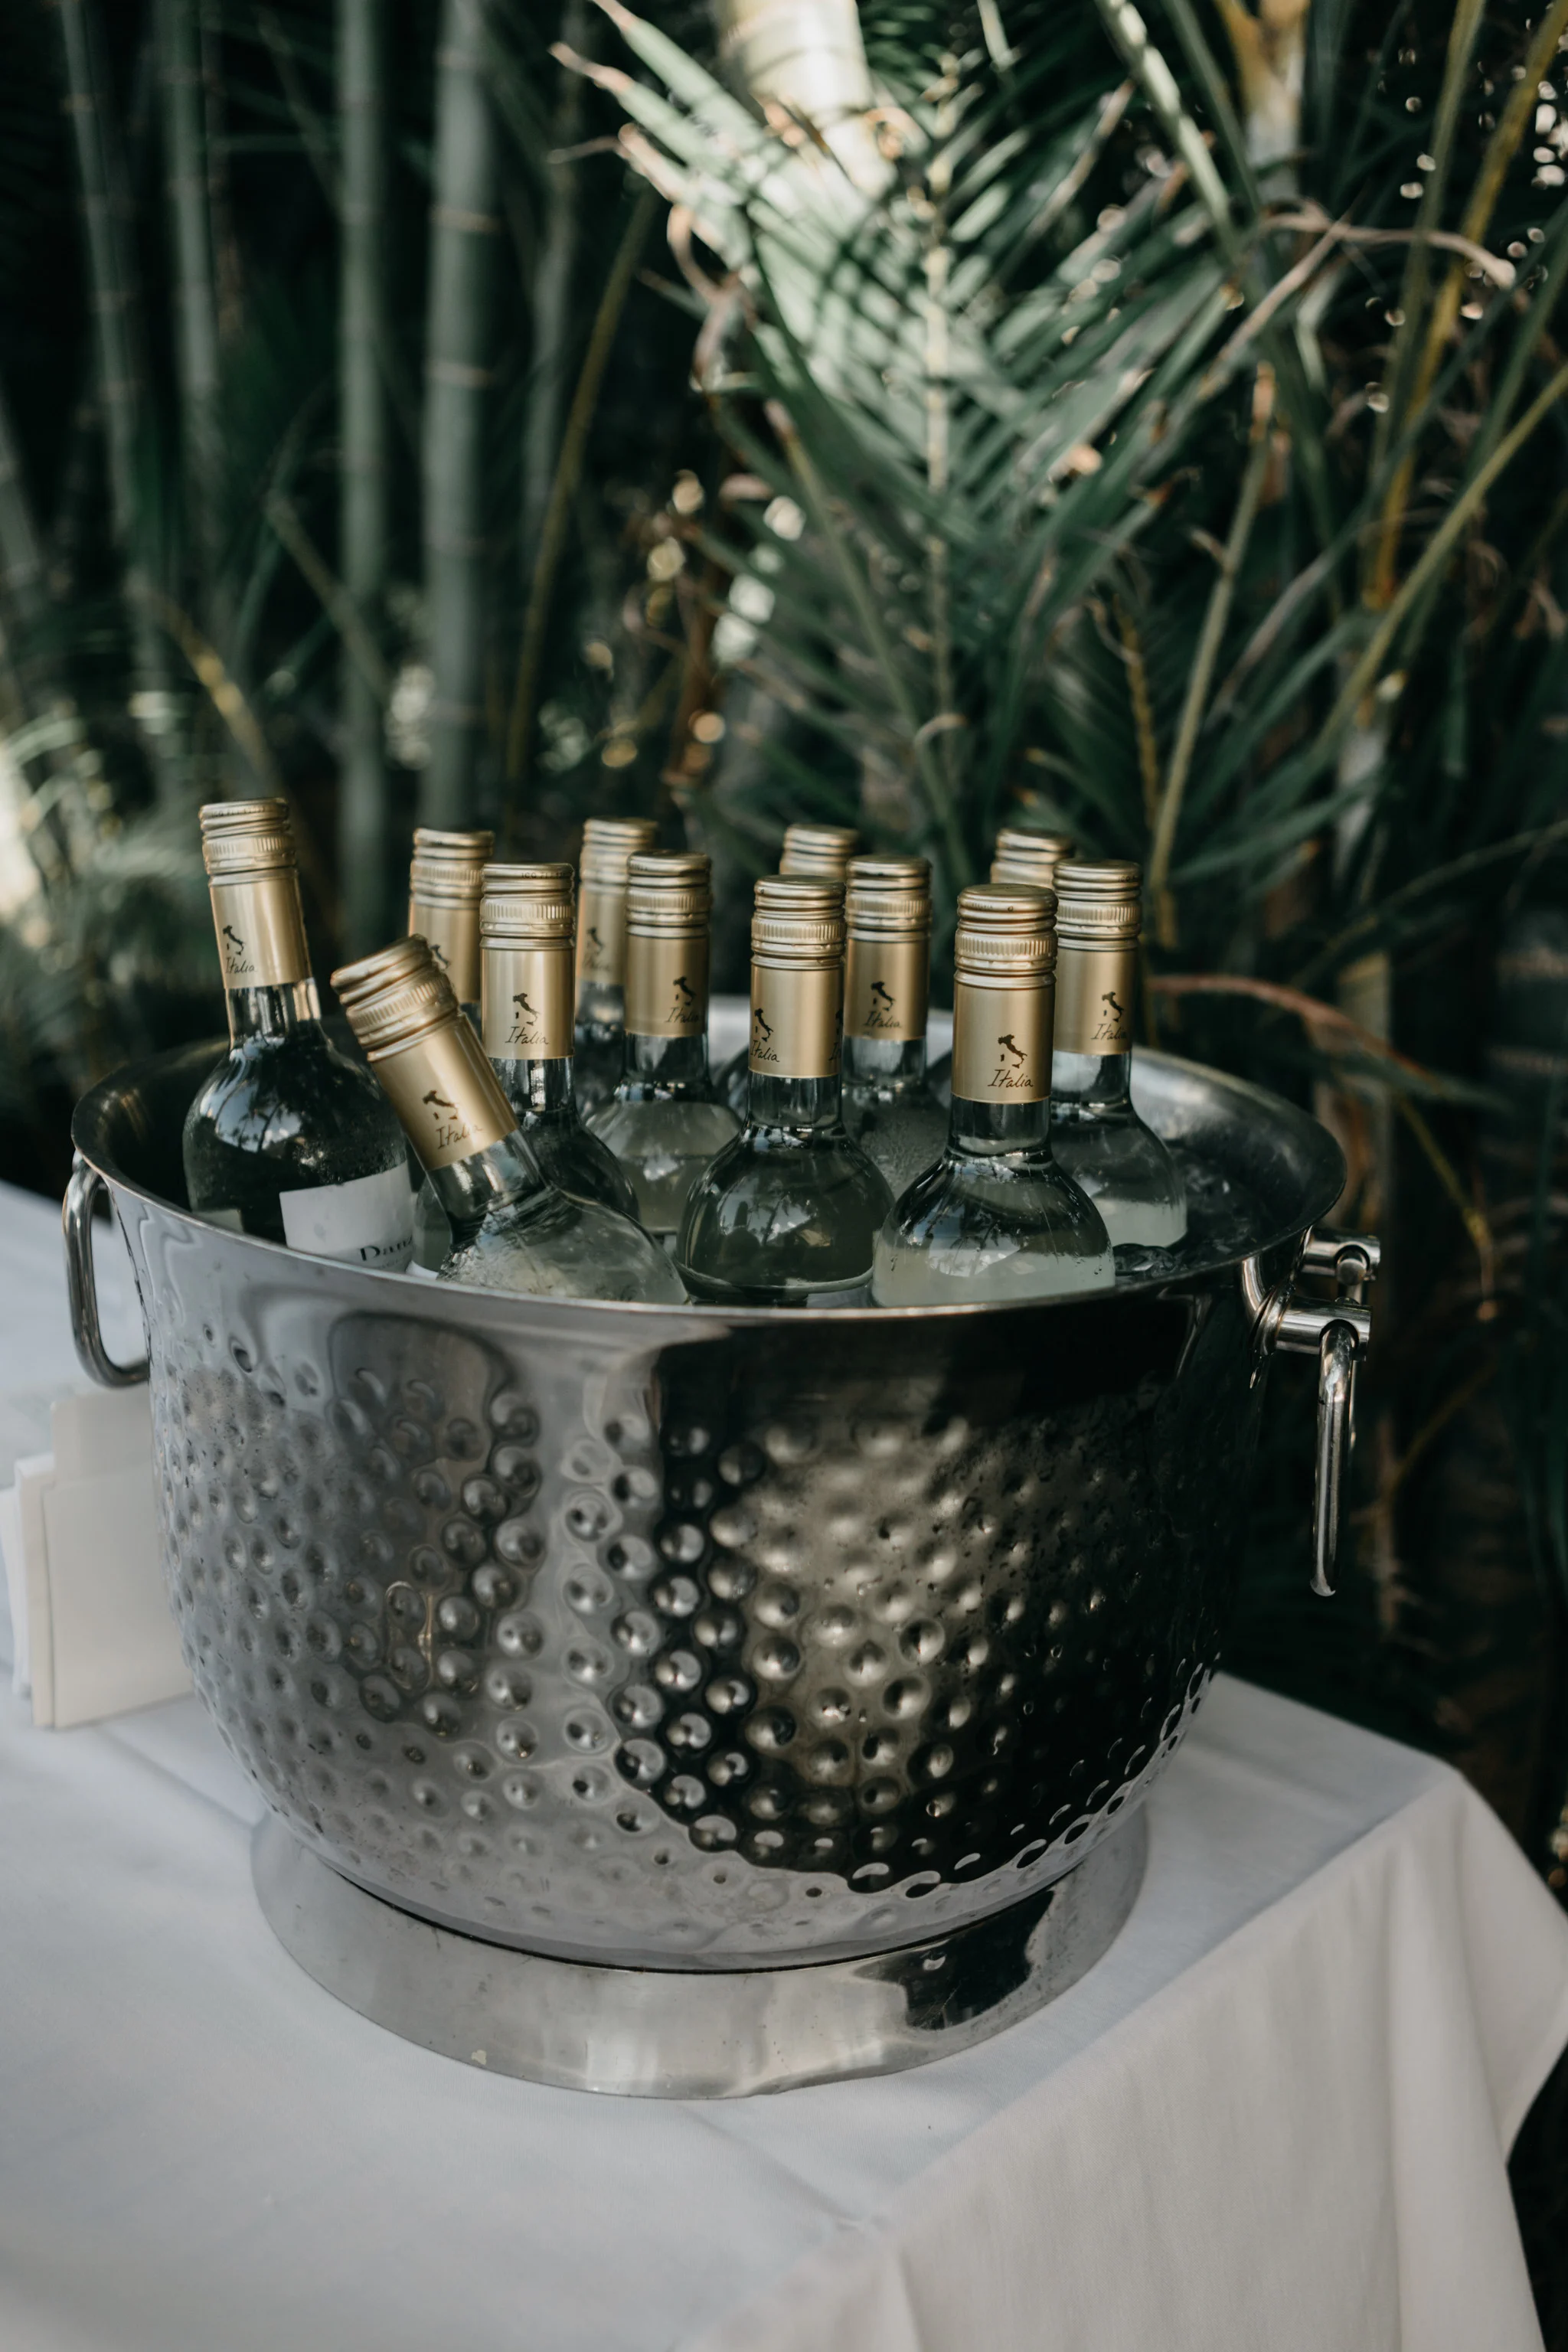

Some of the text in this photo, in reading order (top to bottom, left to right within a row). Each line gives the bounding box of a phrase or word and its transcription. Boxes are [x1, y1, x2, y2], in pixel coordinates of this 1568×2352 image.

[224, 956, 257, 974] Italia
[665, 1007, 700, 1024] Italia
[862, 1011, 902, 1029] Italia
[505, 1026, 550, 1044] Italia
[1090, 1023, 1128, 1040] Italia
[750, 1039, 781, 1063] Italia
[987, 1069, 1034, 1088] Italia
[436, 1123, 484, 1149] Italia
